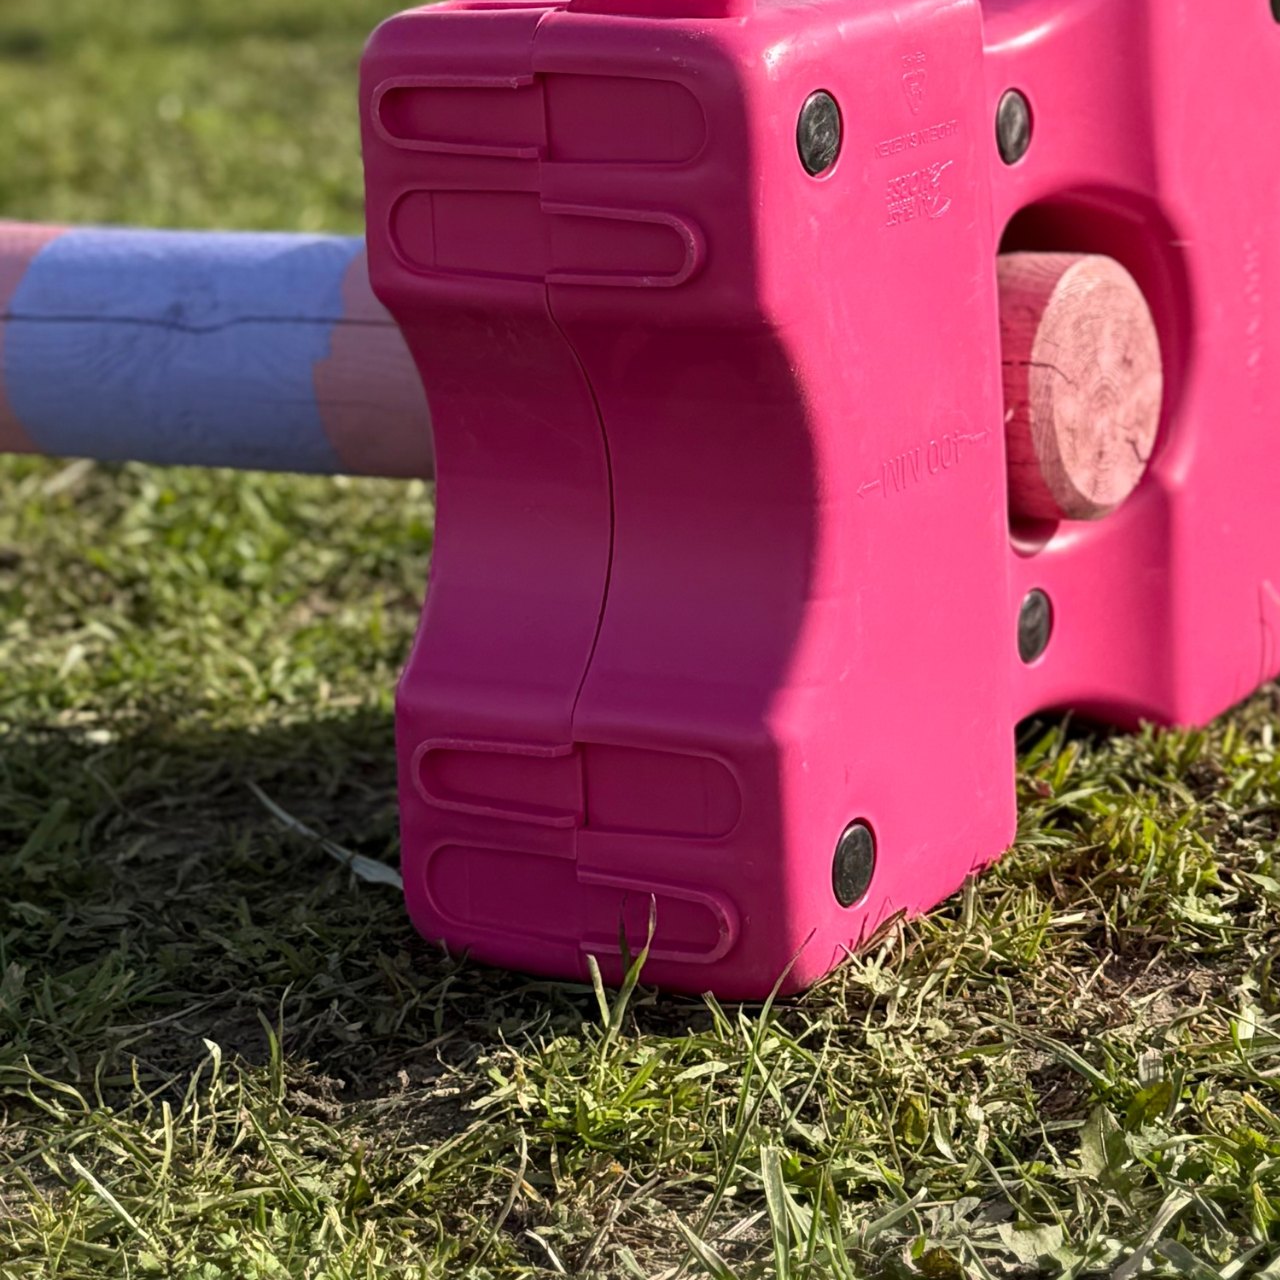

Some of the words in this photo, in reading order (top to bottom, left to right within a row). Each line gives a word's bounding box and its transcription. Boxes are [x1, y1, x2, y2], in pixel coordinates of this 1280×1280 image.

[918, 130, 931, 146] IN
[931, 119, 959, 142] MADE
[874, 132, 918, 160] SWEDEN
[927, 430, 970, 475] 400
[881, 447, 920, 498] MM
